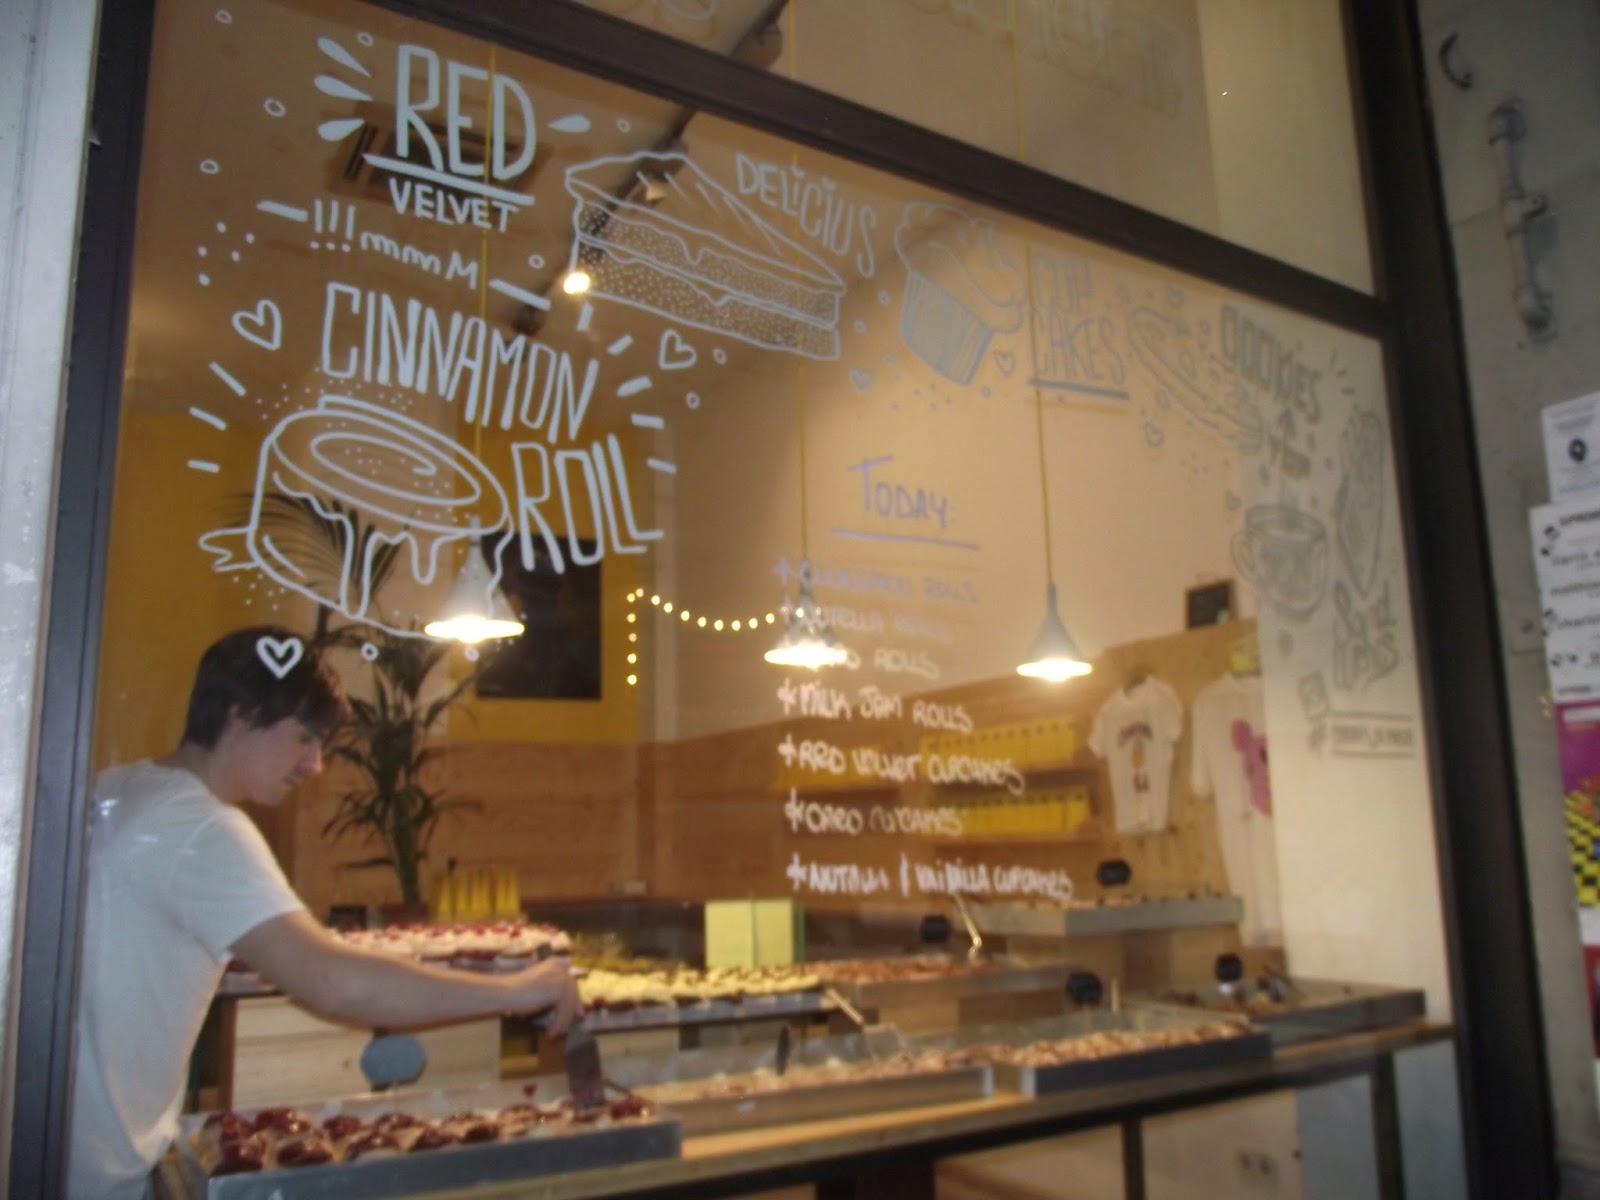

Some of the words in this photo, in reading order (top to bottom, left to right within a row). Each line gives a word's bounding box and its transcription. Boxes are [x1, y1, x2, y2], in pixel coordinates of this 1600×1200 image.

[397, 45, 537, 180] RED
[389, 178, 518, 232] VELVET
[322, 281, 598, 444] CINNAMON
[1031, 306, 1127, 386] CAKES
[511, 433, 664, 574] ROLL
[912, 700, 973, 734] ROLLS
